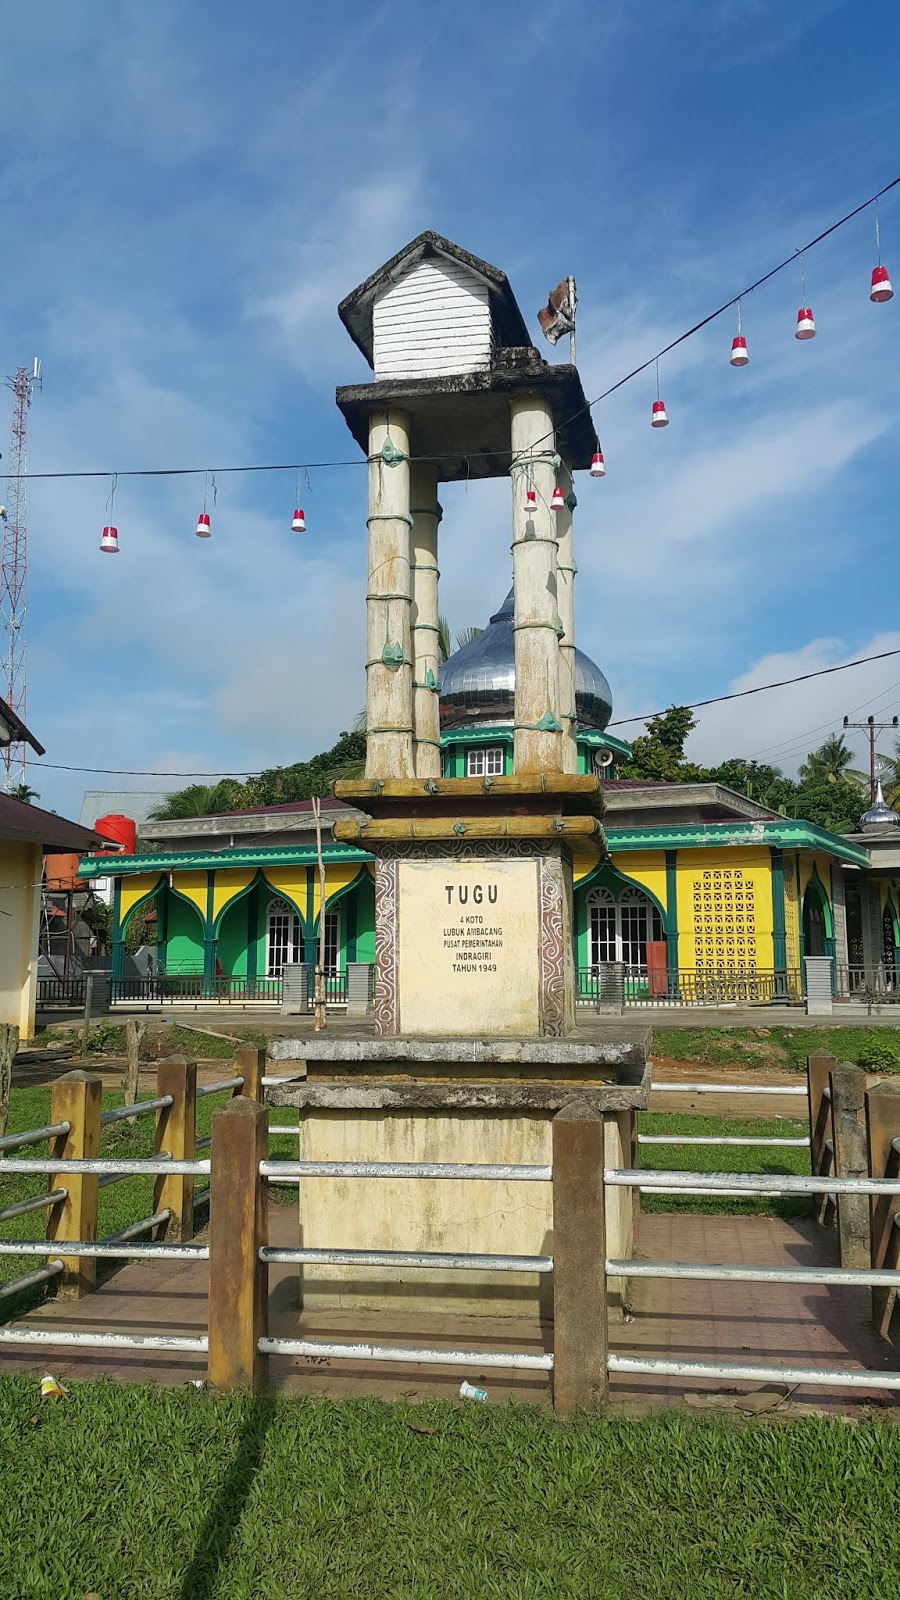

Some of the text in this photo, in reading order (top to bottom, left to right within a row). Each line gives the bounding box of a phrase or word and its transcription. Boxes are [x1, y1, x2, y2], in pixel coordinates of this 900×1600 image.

[444, 884, 498, 905] TUGU
[459, 915, 484, 924] 4 KOTO
[443, 927, 503, 937] LUBUK AMBACANG
[443, 939, 503, 949] PUSAT PEMERINTAHAN
[455, 952, 492, 961] INDRAGIRI
[452, 963, 497, 973] TAHUN 1949
